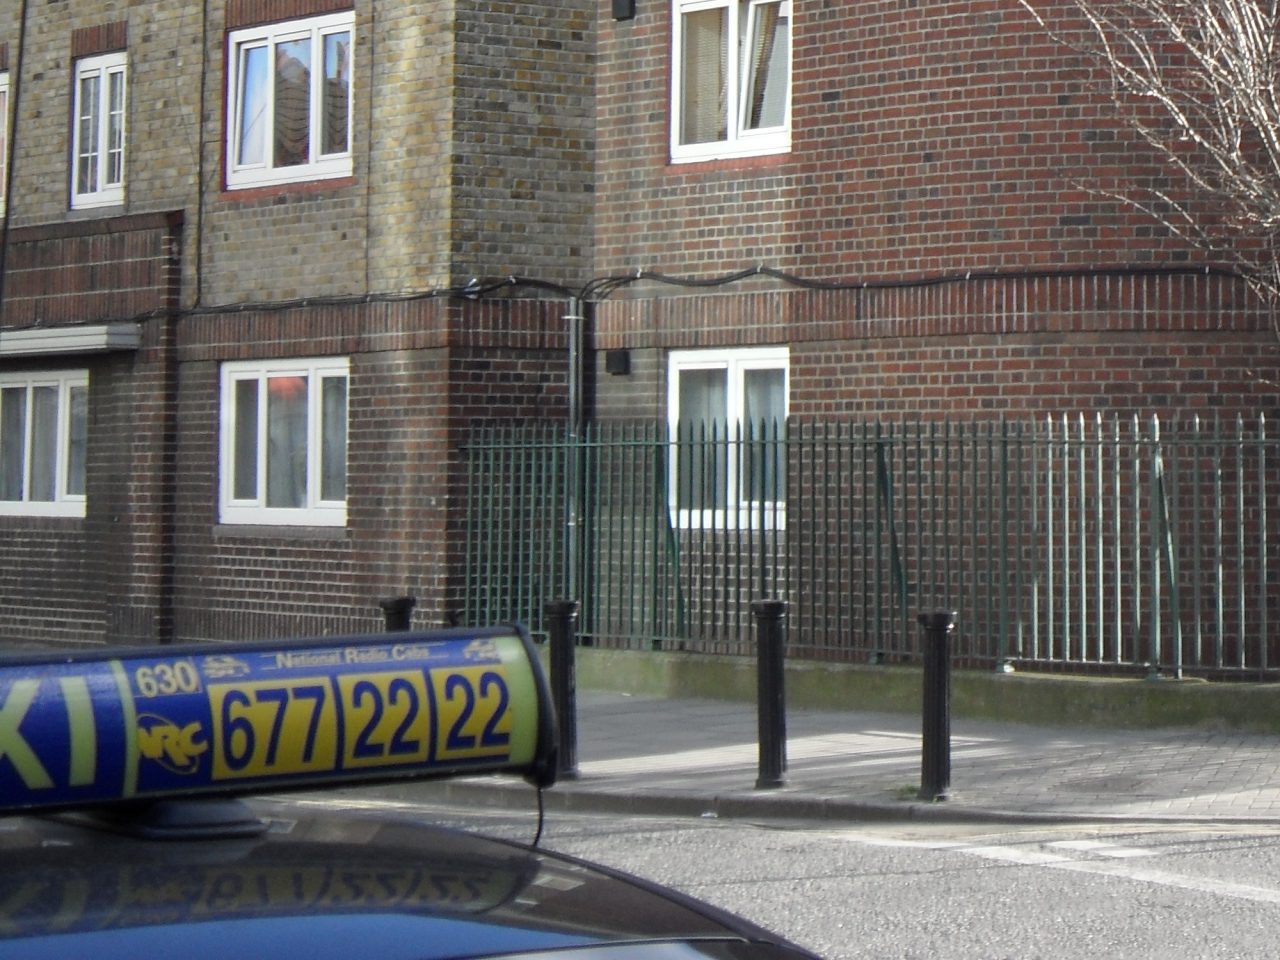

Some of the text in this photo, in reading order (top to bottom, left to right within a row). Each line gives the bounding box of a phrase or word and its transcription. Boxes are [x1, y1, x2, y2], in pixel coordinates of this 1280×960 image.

[136, 661, 198, 698] 630
[221, 671, 510, 772] 677 22 22
